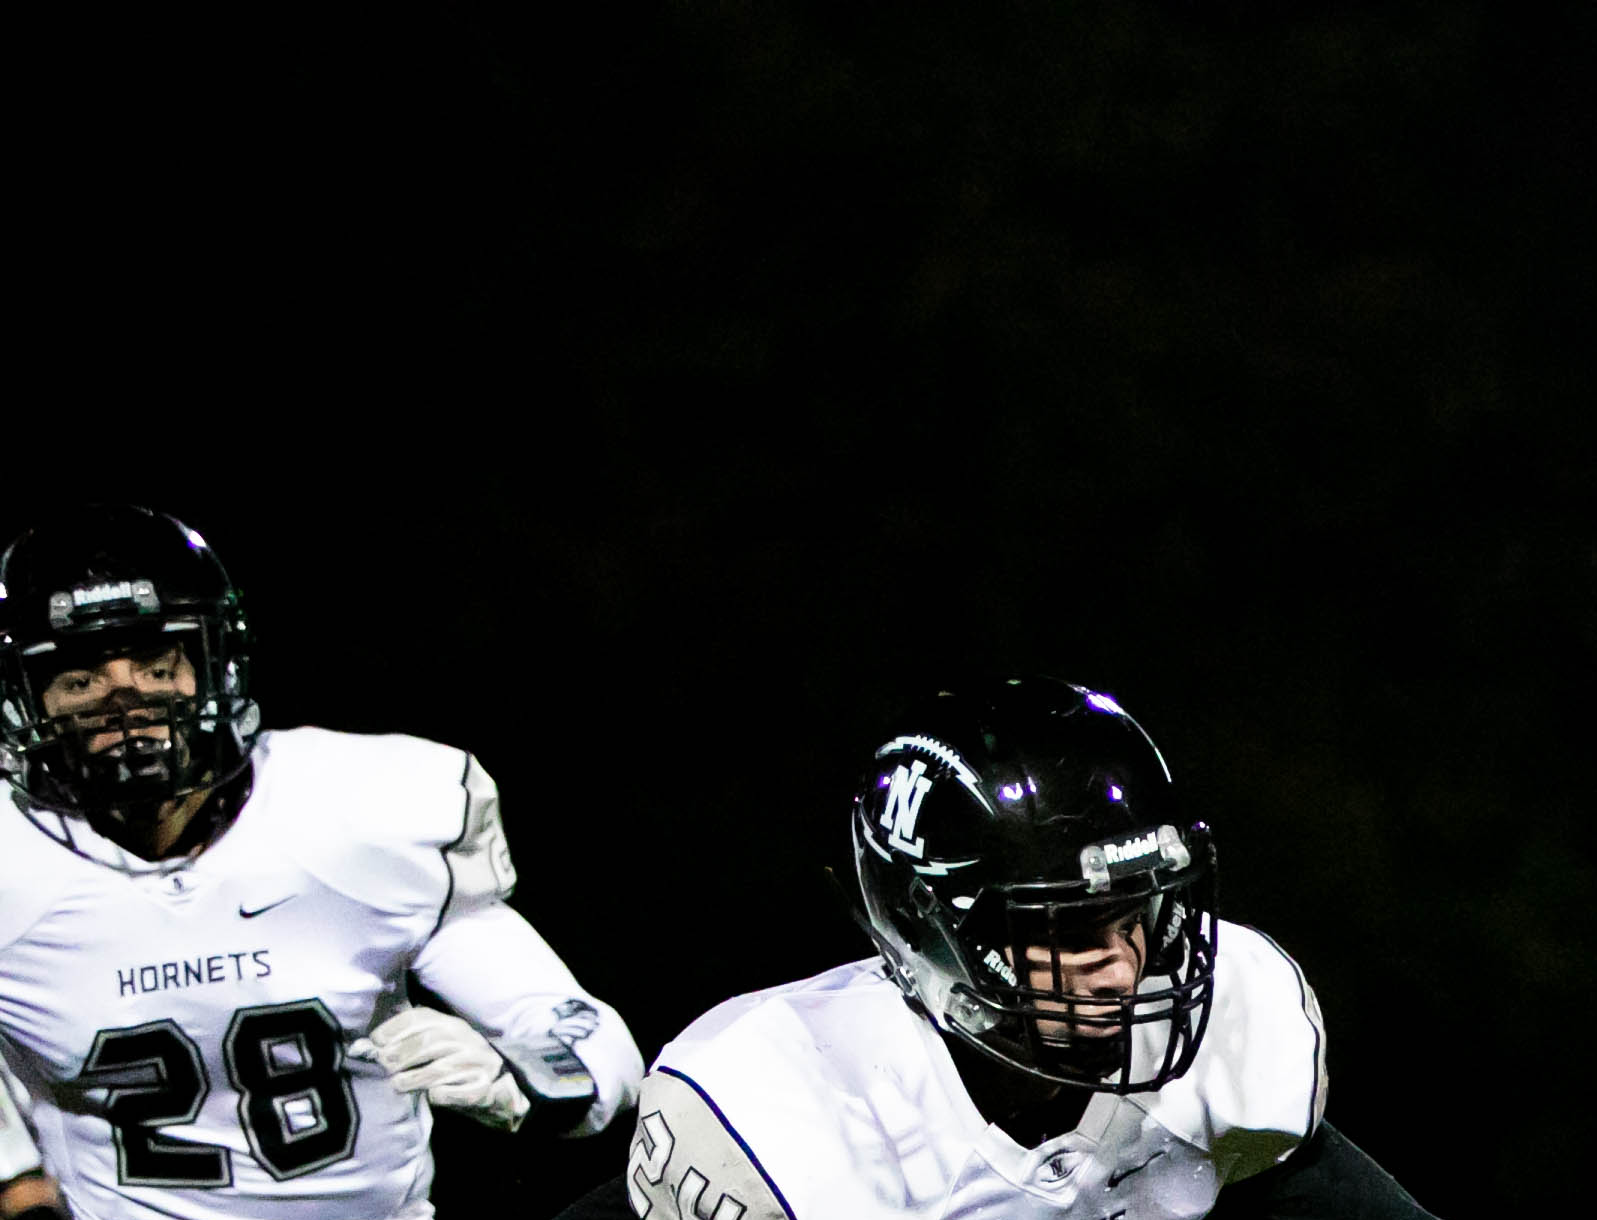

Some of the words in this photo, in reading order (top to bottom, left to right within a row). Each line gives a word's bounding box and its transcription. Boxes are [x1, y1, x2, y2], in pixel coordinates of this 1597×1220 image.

[1104, 832, 1159, 864] Riddell
[117, 950, 272, 997] HORNETS
[79, 997, 361, 1188] 28
